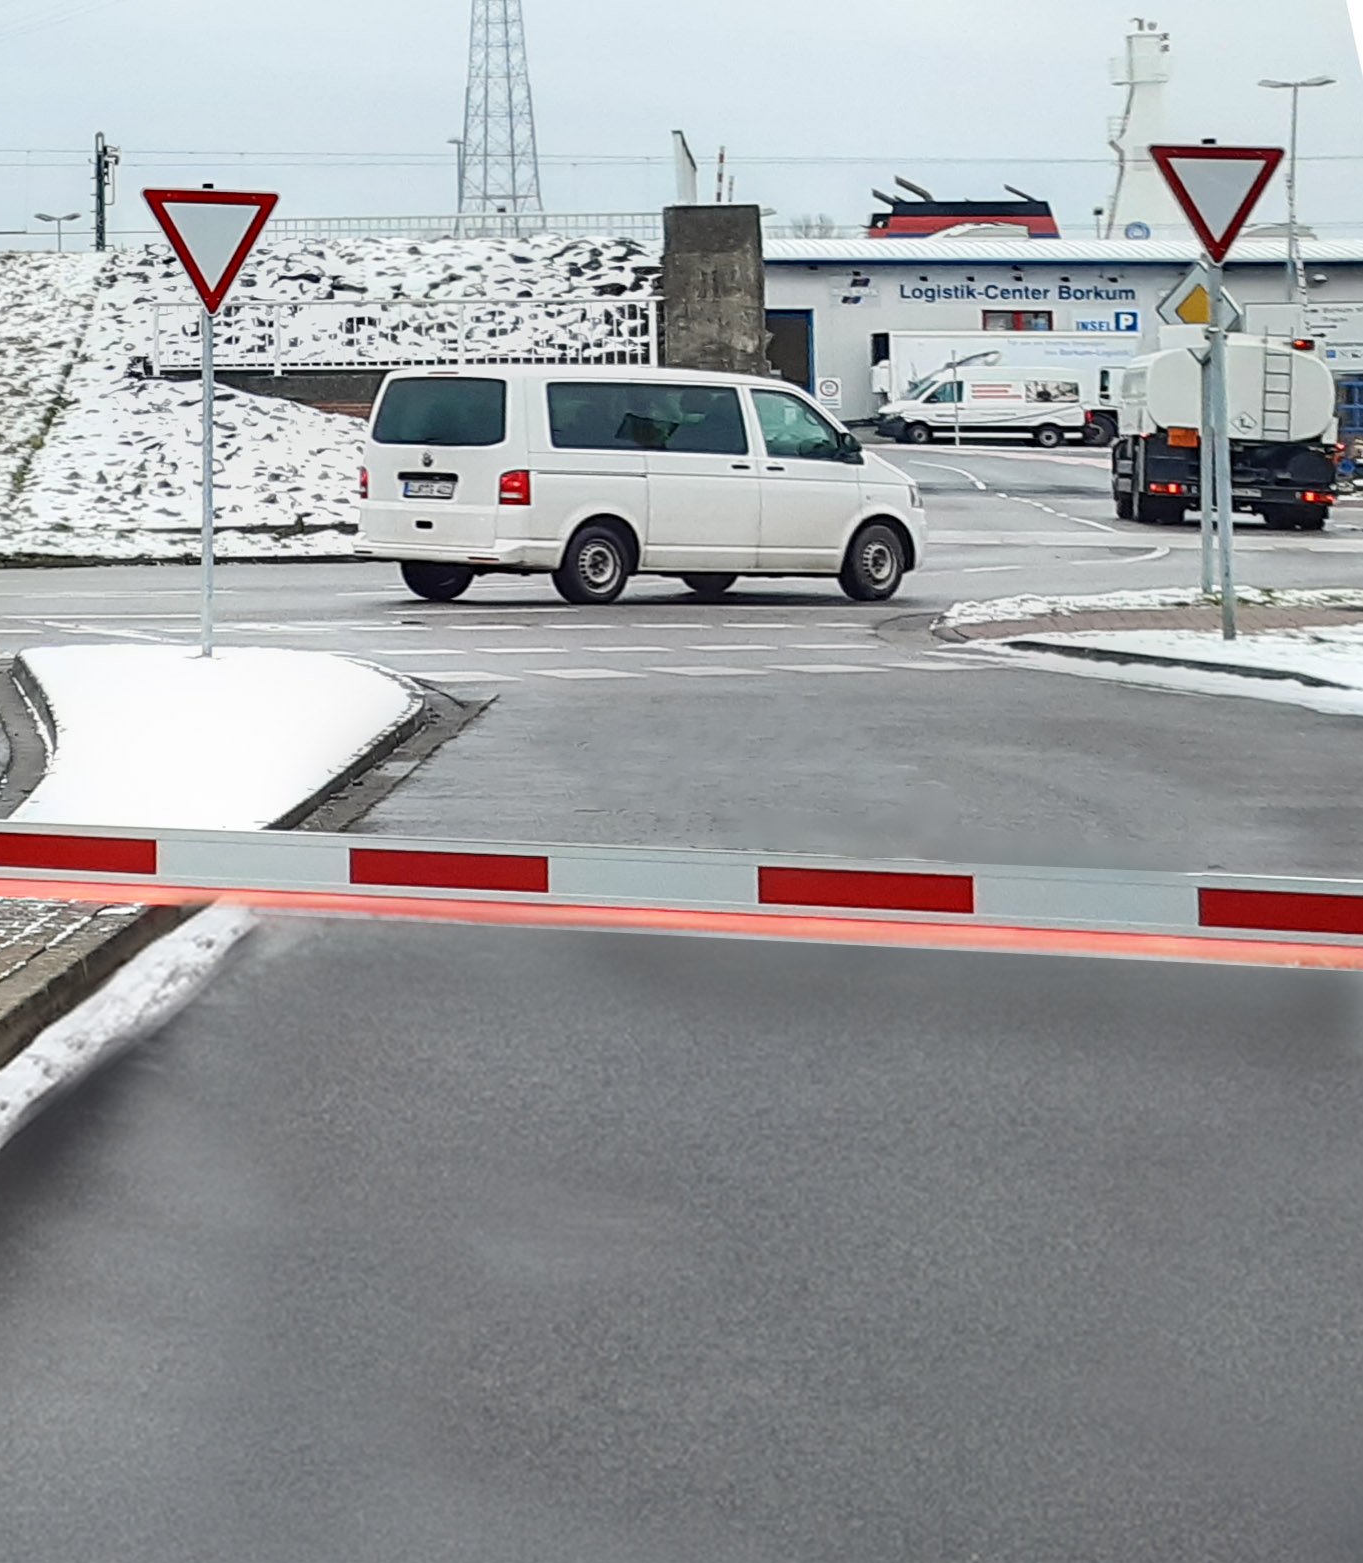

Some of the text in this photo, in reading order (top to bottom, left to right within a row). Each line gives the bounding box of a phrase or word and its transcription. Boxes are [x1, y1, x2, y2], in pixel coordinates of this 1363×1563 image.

[899, 284, 1051, 303] Logistik-Center
[1057, 285, 1136, 300] Borkum
[1076, 313, 1135, 331] INSEL P
